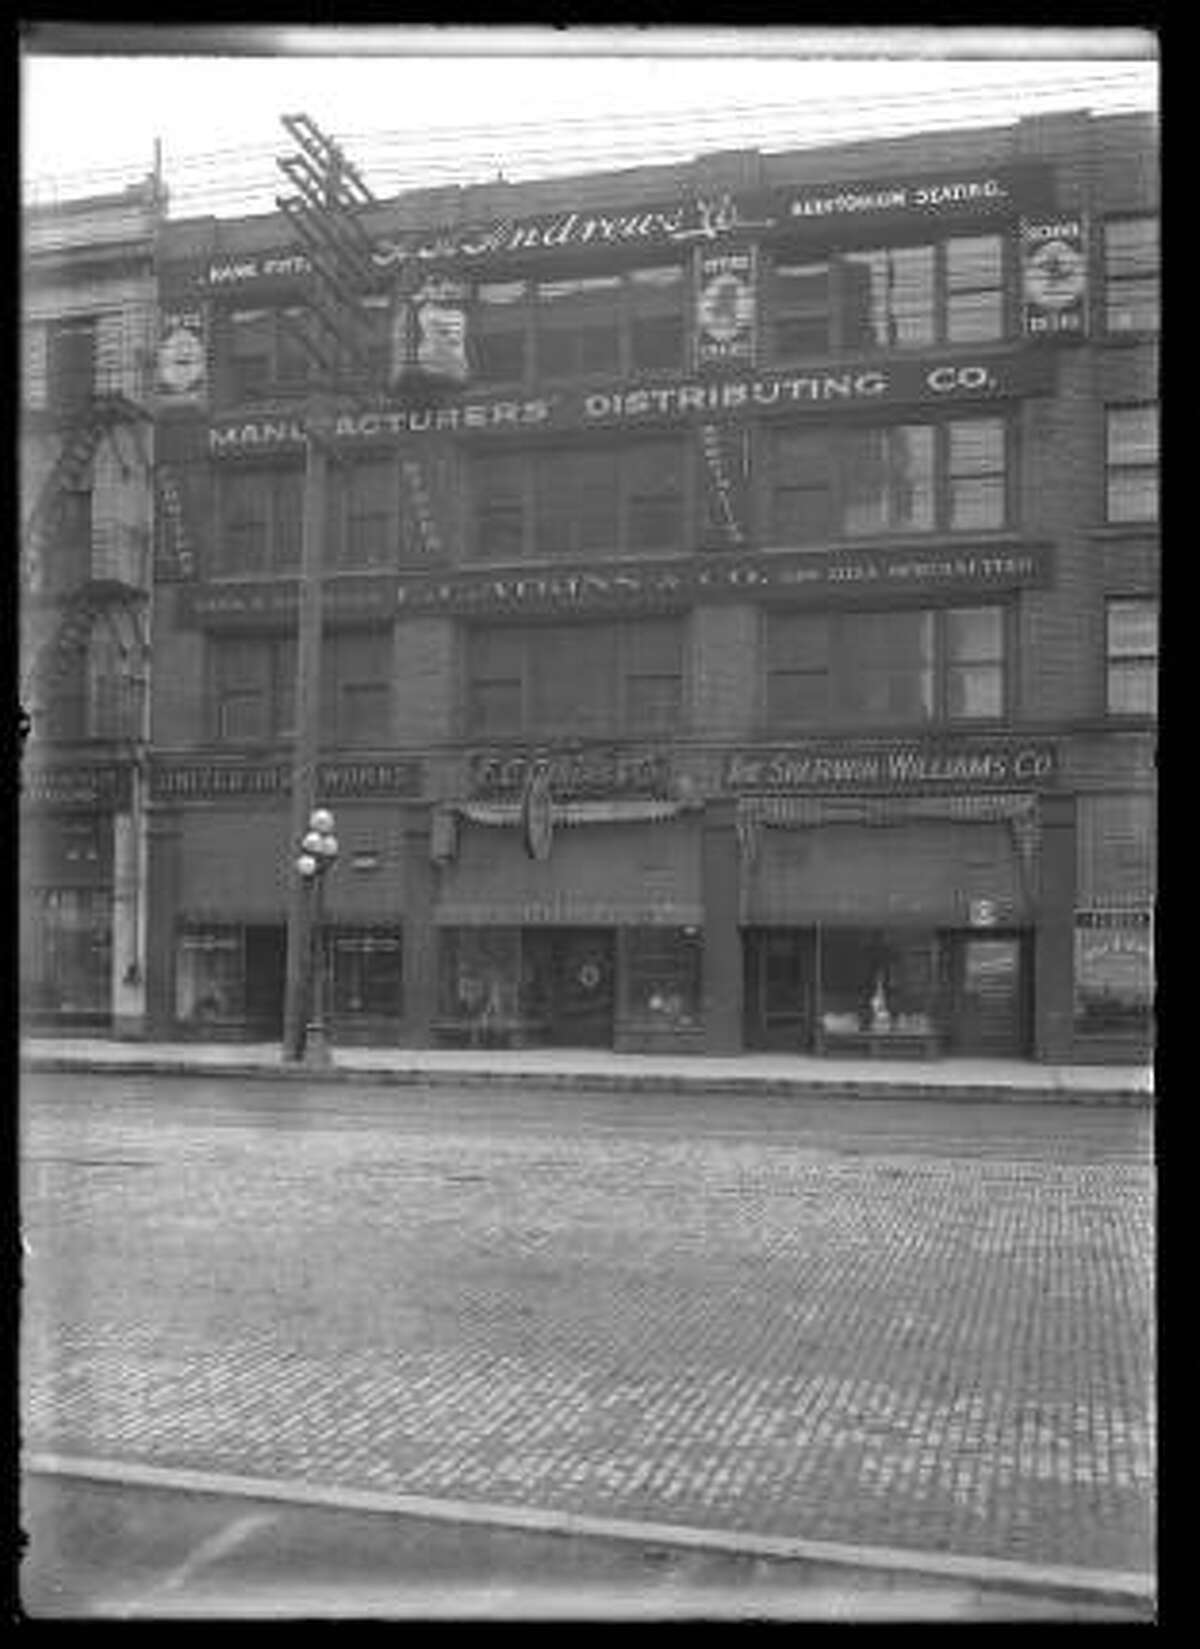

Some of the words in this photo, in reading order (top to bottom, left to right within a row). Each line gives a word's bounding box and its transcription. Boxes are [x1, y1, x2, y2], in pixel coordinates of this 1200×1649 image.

[208, 401, 549, 451] MANUACTURERS
[584, 373, 889, 419] DISTRIBUTING
[926, 365, 999, 392] CO.
